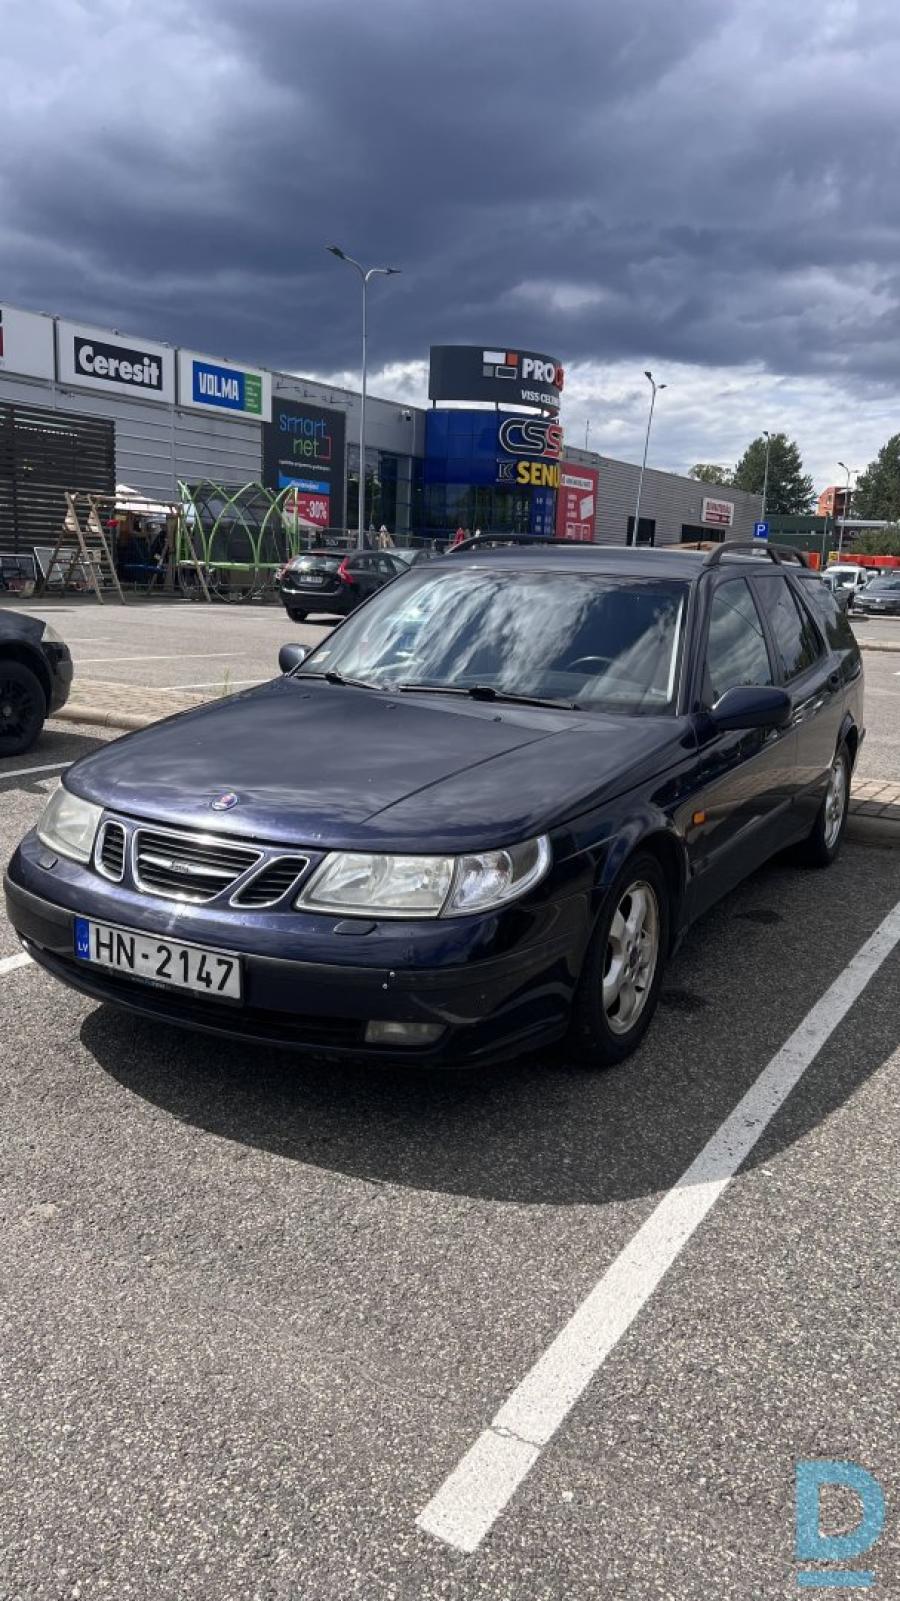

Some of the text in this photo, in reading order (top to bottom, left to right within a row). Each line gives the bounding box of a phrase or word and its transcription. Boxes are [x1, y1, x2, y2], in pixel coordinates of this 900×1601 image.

[78, 345, 160, 385] Ceresit
[198, 372, 239, 400] VOLMA
[279, 414, 327, 438] smart
[499, 417, 563, 458] CSS
[293, 438, 320, 457] net
[757, 524, 766, 536] P
[78, 943, 89, 953] LV
[95, 928, 234, 991] HN-2147
